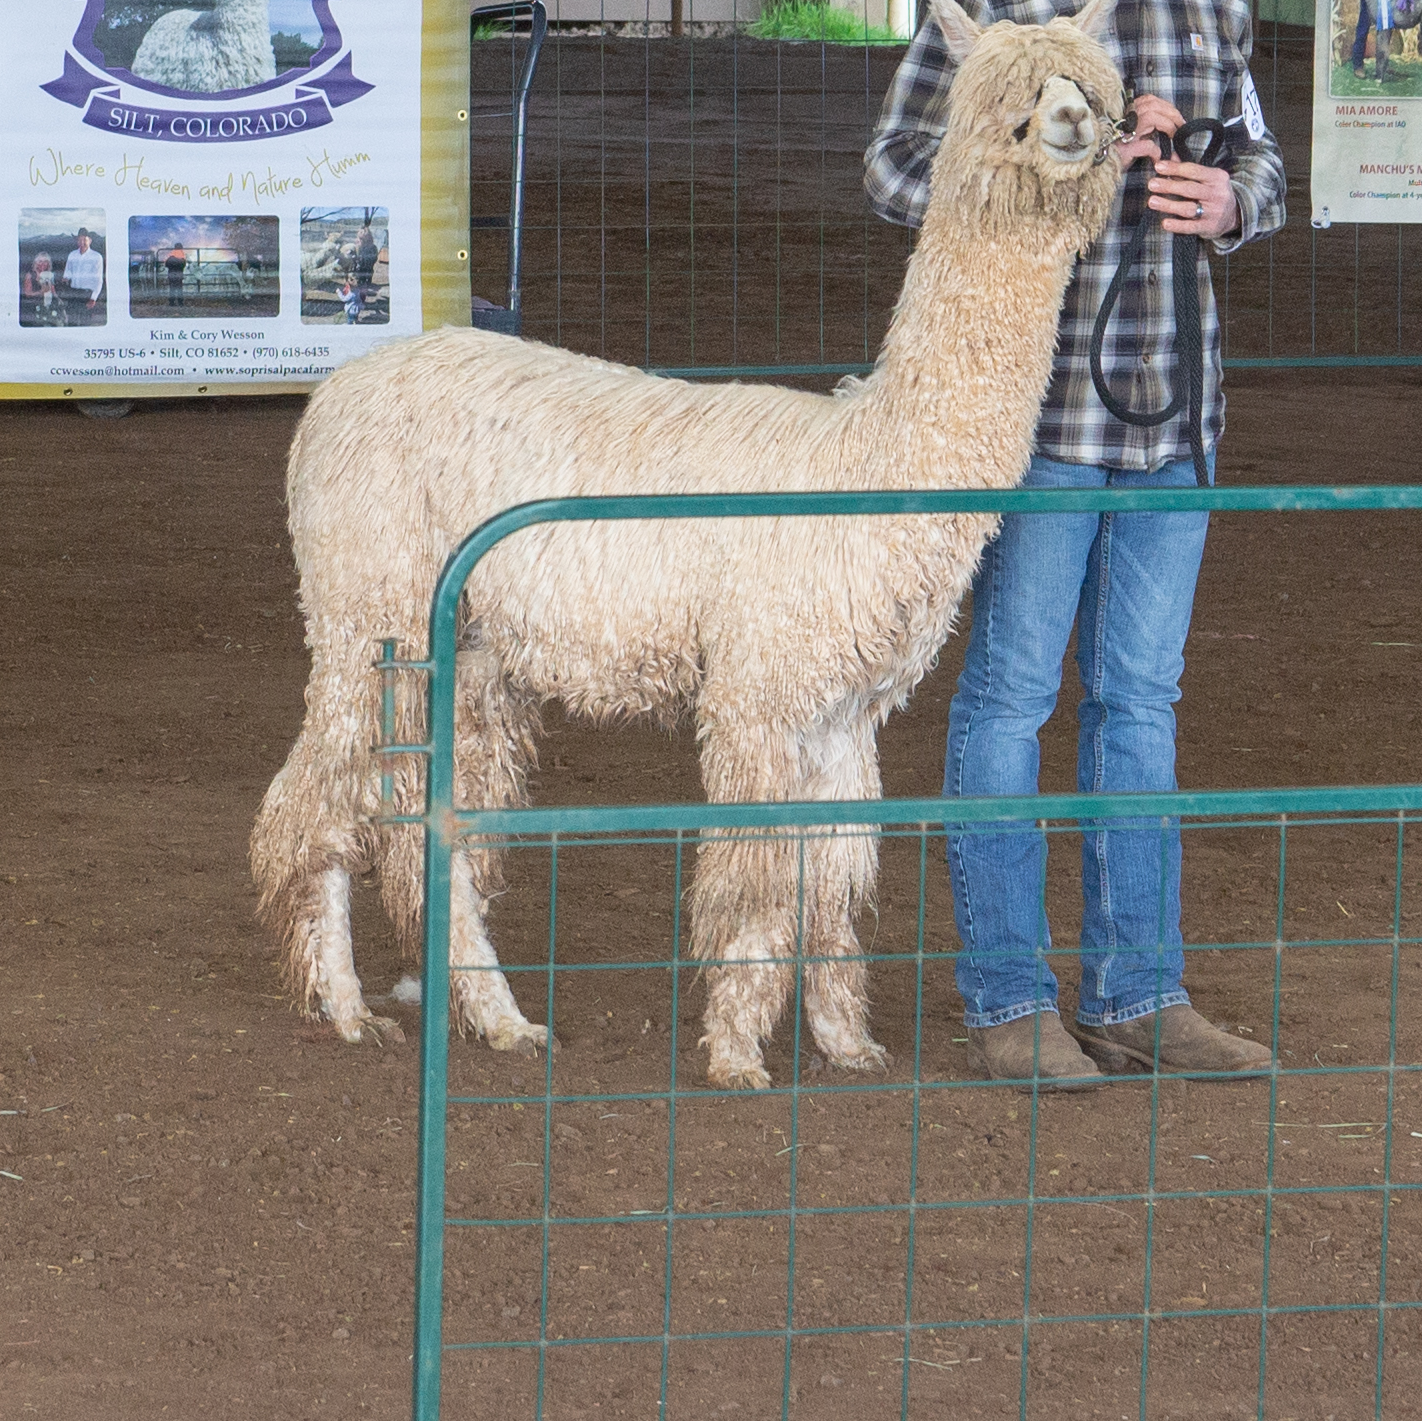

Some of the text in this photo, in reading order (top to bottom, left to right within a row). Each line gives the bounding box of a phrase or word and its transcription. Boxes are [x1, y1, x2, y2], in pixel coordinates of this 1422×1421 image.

[1335, 106, 1398, 116] MIA AMORE
[108, 107, 307, 138] SILT, COLORADO
[1335, 120, 1351, 128] Color
[1353, 120, 1385, 129] Champion
[1387, 120, 1394, 128] at
[1360, 164, 1415, 175] MANCHU'S
[29, 147, 372, 206] Where Heaven and Nature Humm
[1349, 191, 1366, 199] Color
[1367, 191, 1401, 200] Champion
[1402, 191, 1409, 199] at
[150, 329, 265, 343] Kim & Cory Wesson
[83, 346, 330, 359] 35795 US-6 Silt, CO 81652 (970) 618-6435
[50, 366, 185, 377] ccwesson@hotmail.com
